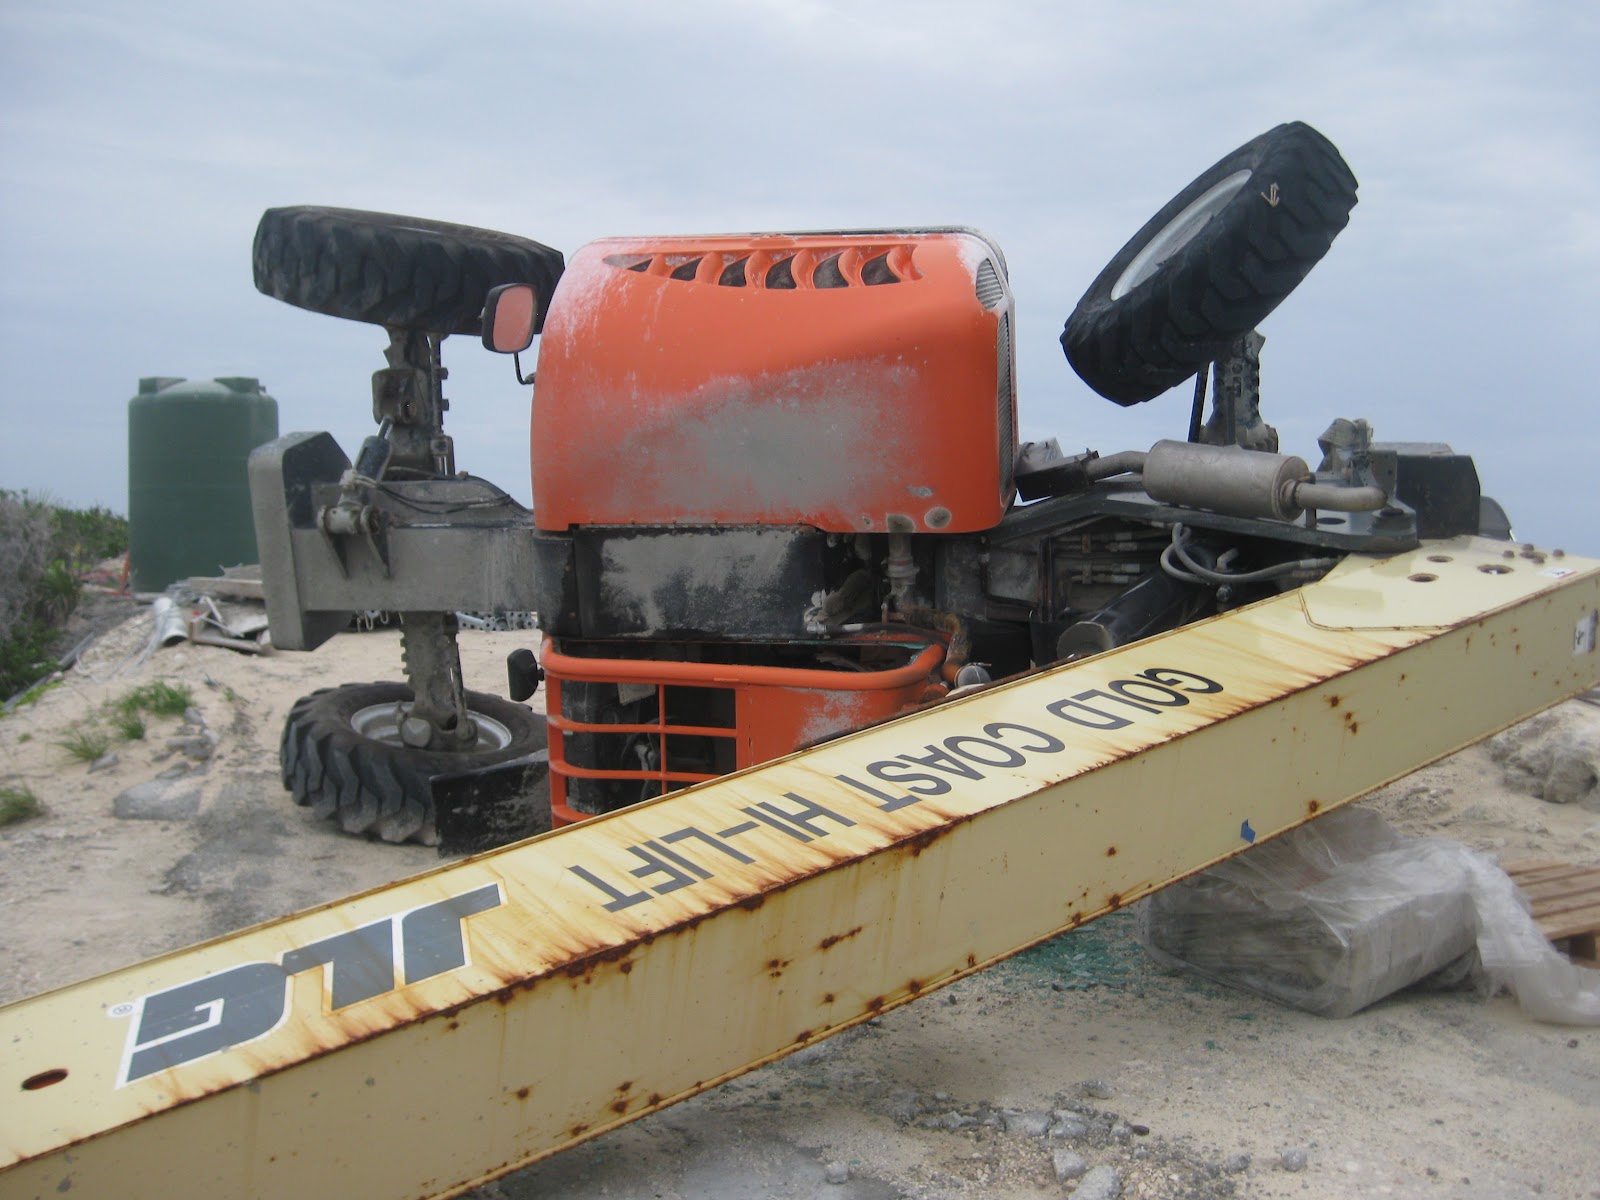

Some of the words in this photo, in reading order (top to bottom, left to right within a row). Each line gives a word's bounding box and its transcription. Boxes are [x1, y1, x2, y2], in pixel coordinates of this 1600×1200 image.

[1046, 667, 1224, 730] GOLD
[835, 721, 1066, 812] COAST
[567, 792, 858, 912] HI-LIFT
[121, 882, 505, 1085] JLG
